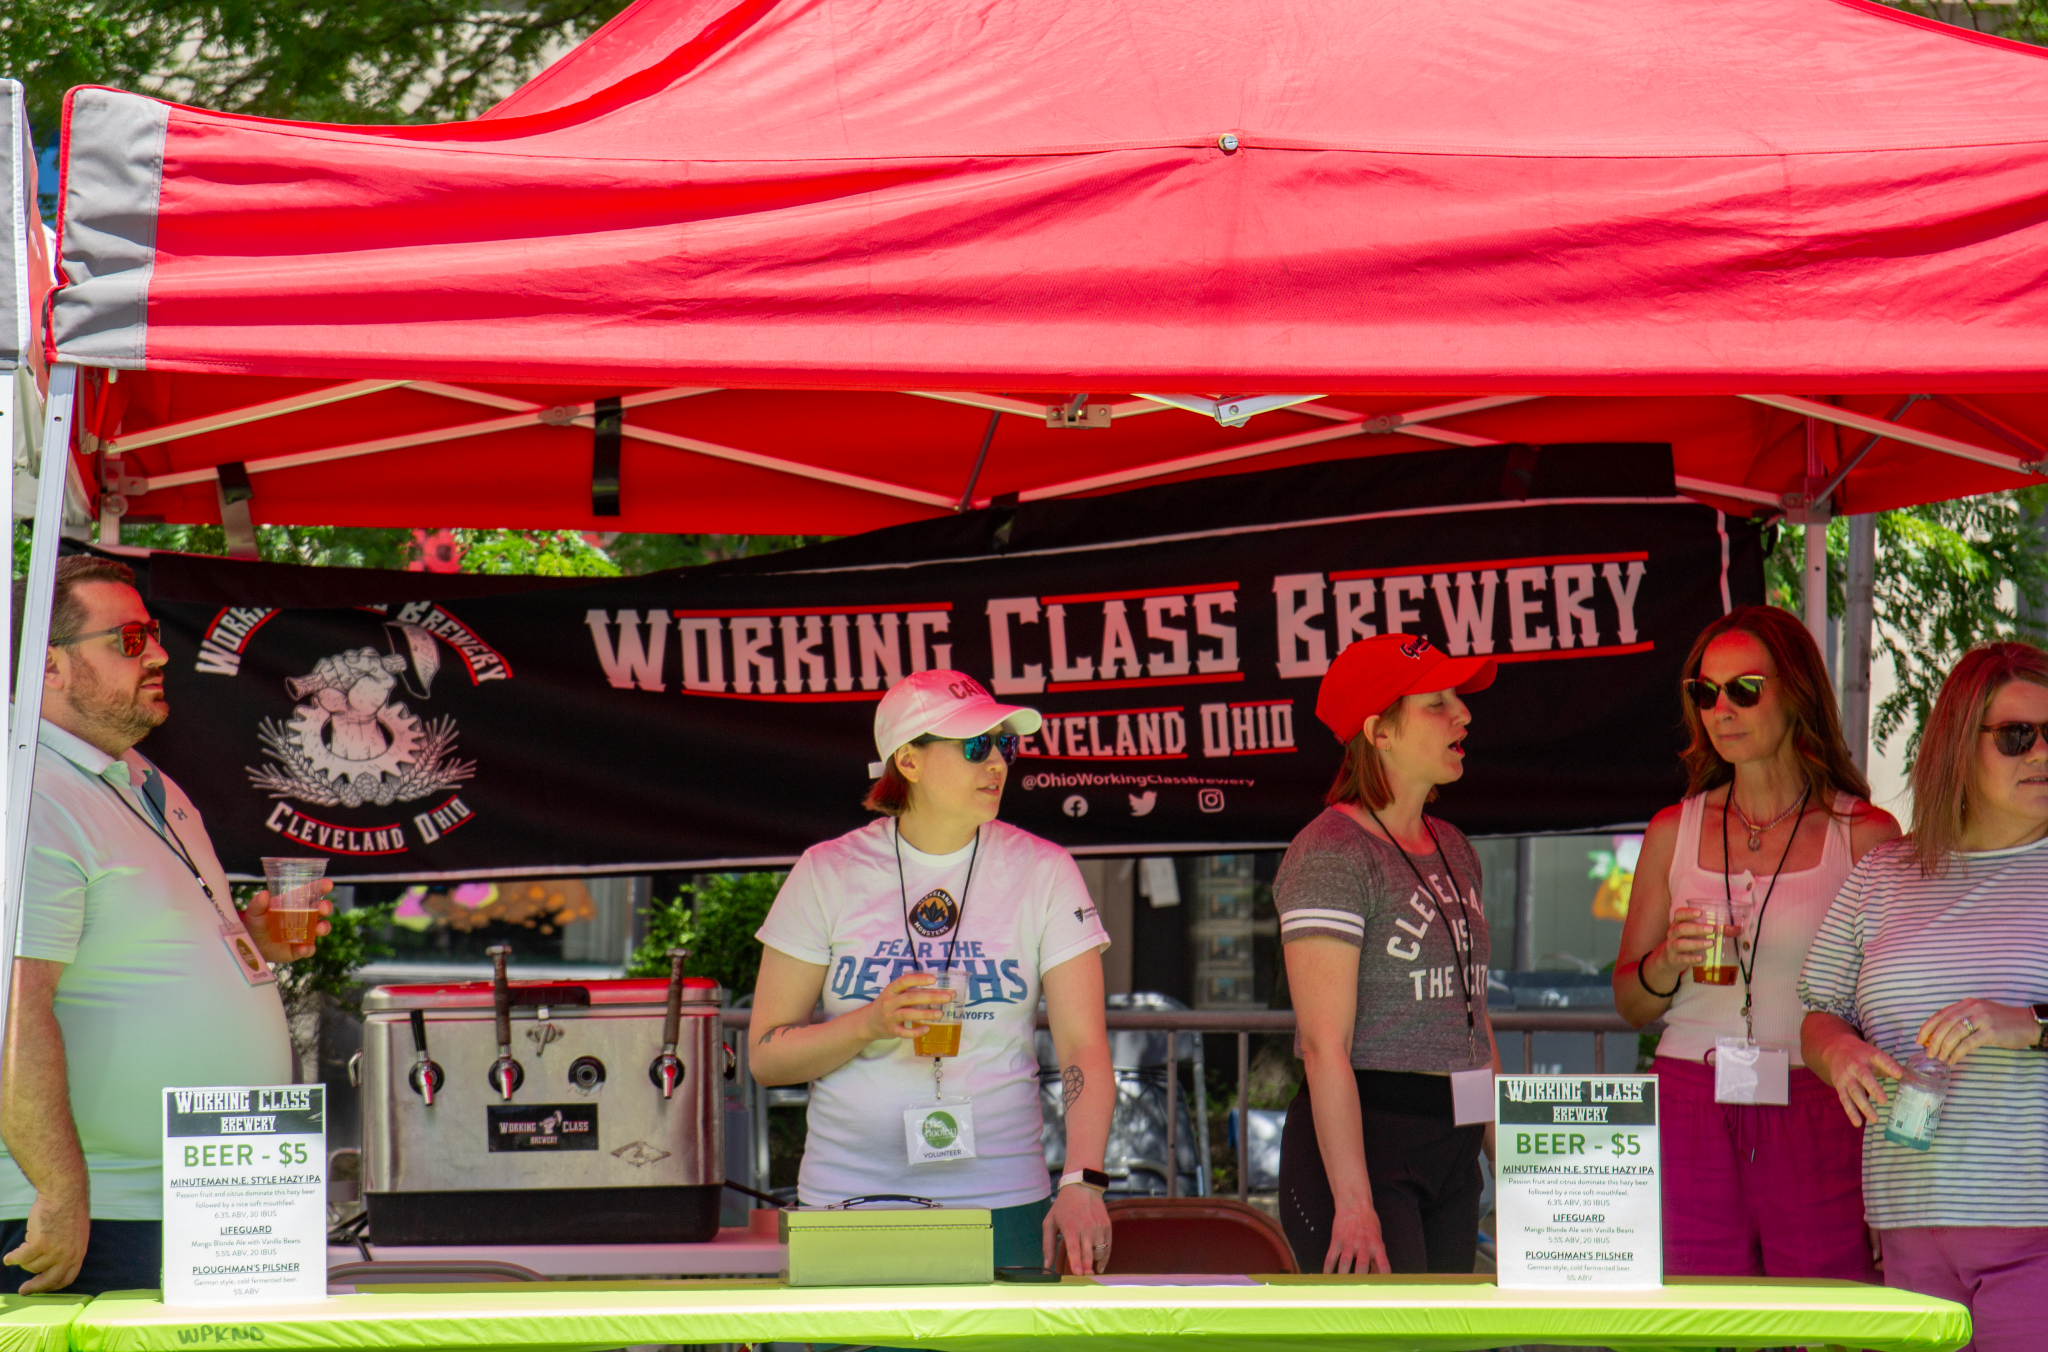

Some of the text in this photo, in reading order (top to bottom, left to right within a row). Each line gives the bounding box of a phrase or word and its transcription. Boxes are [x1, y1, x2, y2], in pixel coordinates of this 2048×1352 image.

[584, 560, 1647, 695] WORKING CLASS BREWERY
[1017, 703, 1296, 757] EVELAND OHIO
[1021, 773, 1256, 790] @OhioWorkingClassBrewery
[265, 798, 471, 853] CLEVELAND OHIO
[914, 921, 949, 936] MONSTERS
[1451, 918, 1474, 952] IS
[874, 939, 985, 958] FEAR THE
[1409, 964, 1488, 1001] THE CIT
[946, 1010, 995, 1020] PLAYOFFS
[1507, 1081, 1643, 1102] WORKING CLASS
[175, 1089, 311, 1113] WORKING CLASS
[1553, 1106, 1608, 1123] BREWERY
[221, 1116, 276, 1133] BREWERY
[499, 1121, 589, 1134] WORKING CLASS
[530, 1136, 558, 1145] BREWERY
[1517, 1133, 1585, 1154] BEER
[1611, 1132, 1641, 1158] $5
[185, 1144, 253, 1167] BEER
[279, 1142, 307, 1168] $5
[924, 1149, 961, 1158] VOLUNTEER
[1503, 1165, 1654, 1174] MINUTEMAN N.E. STYLE HAZY IPA
[170, 1175, 321, 1187] MINUTEMAN N.E. STYLE HAZY IPA
[1553, 1214, 1605, 1222] LIFEGUARD
[220, 1226, 272, 1235] LIFEGUARD
[192, 1240, 212, 1249] Mango
[232, 1249, 248, 1257] ABV,
[1526, 1251, 1633, 1260] PLOUGHMAN'S PILSNER
[193, 1263, 299, 1275] PLOUGHMAN'S PILSNER
[177, 1324, 266, 1344] WPKND
